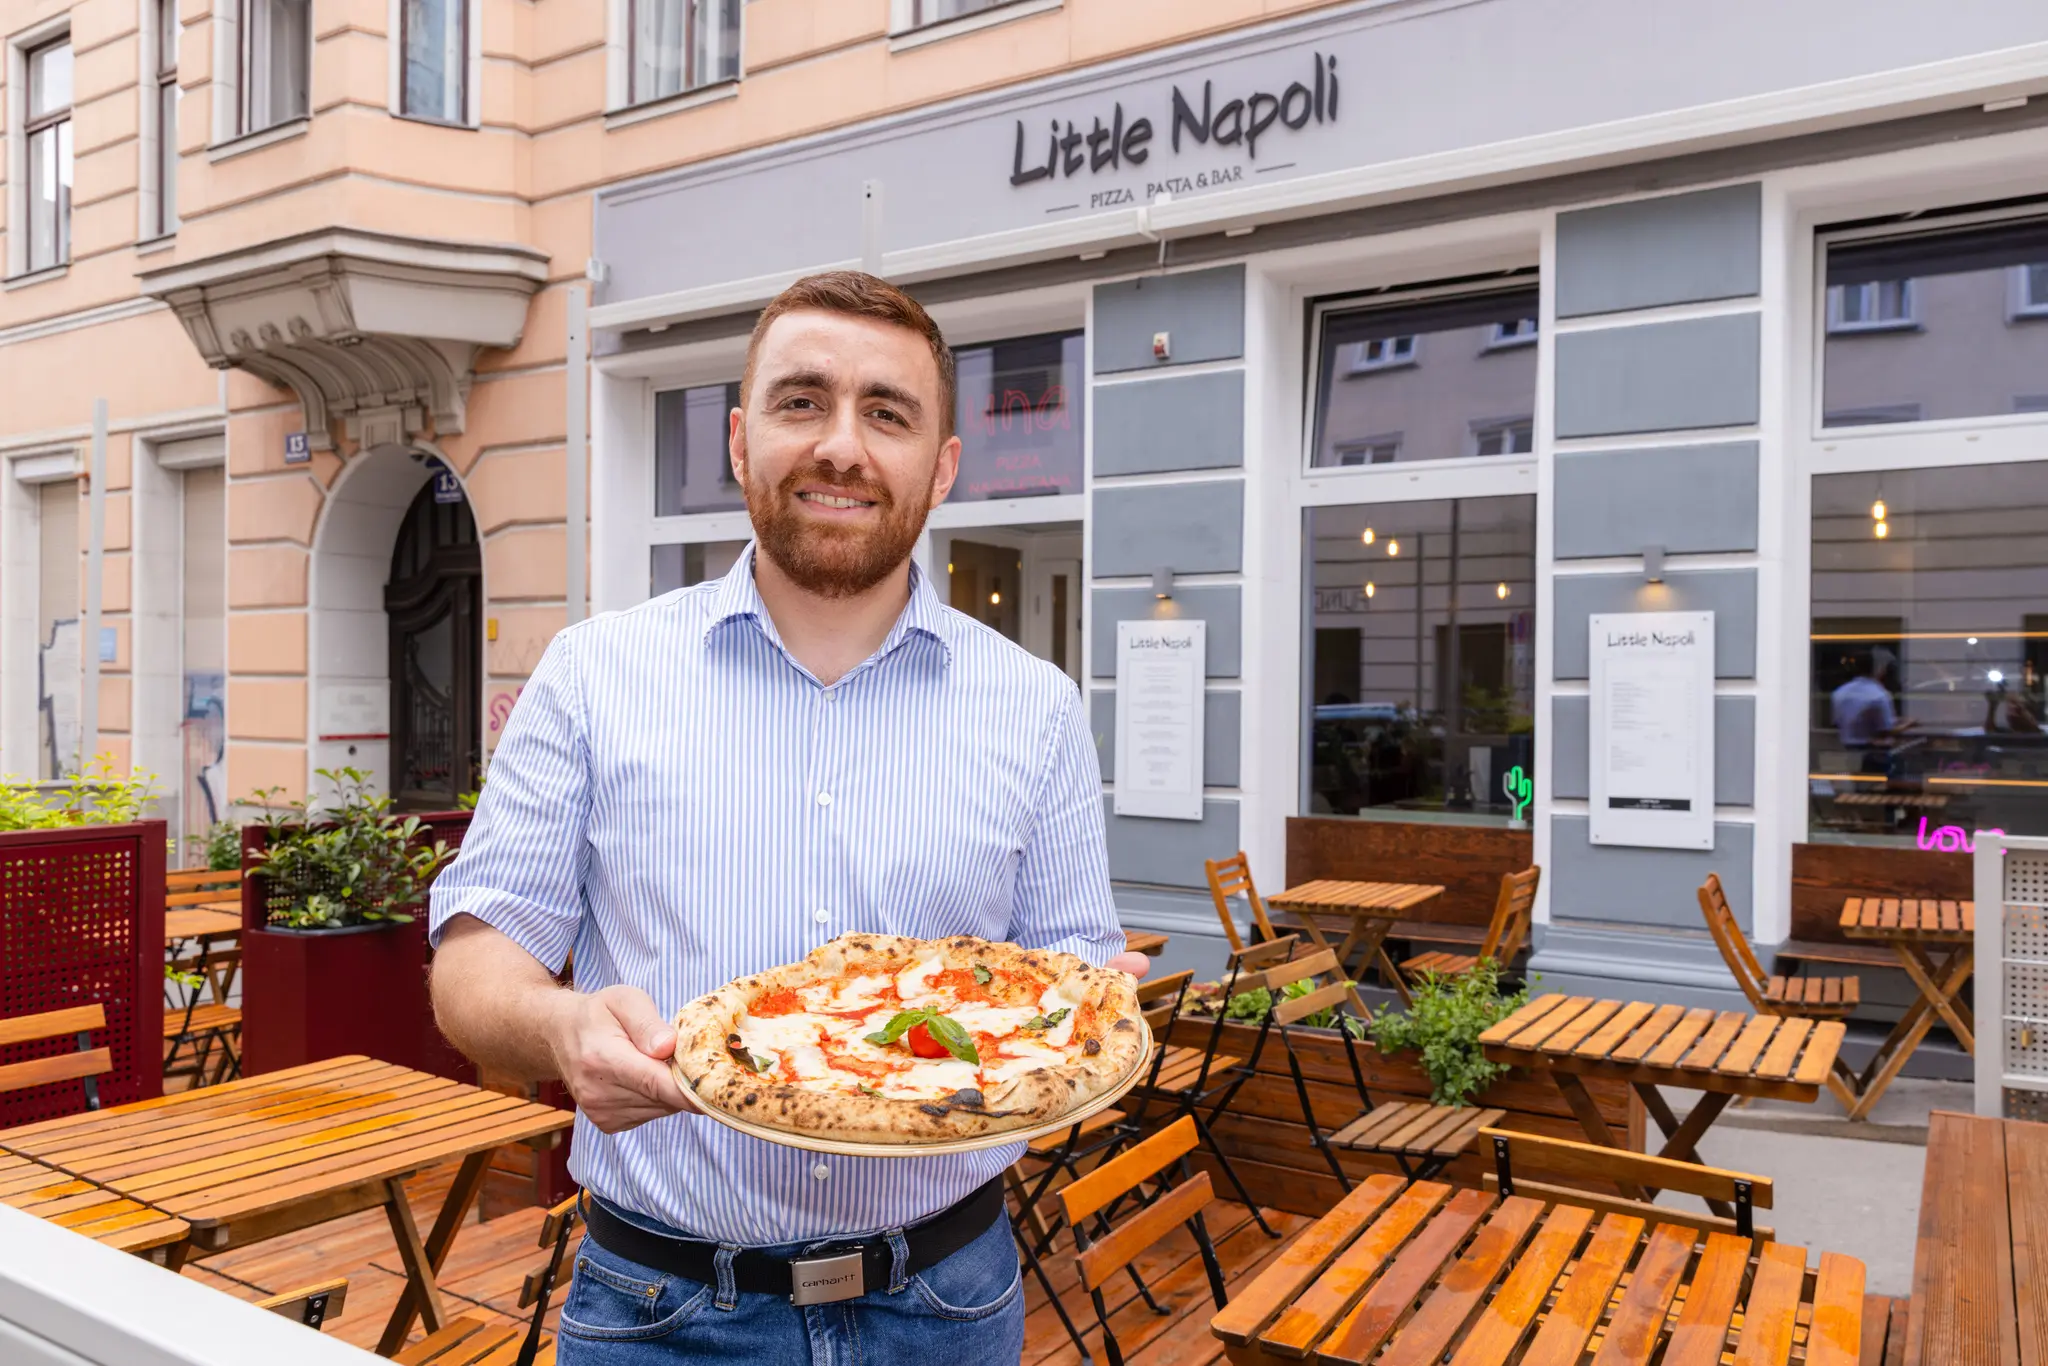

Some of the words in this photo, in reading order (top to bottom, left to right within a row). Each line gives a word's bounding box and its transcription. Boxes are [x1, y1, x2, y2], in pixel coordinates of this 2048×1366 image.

[1010, 102, 1153, 186] Little
[1171, 52, 1339, 160] Napoli
[1091, 188, 1135, 209] PIZZA
[1146, 177, 1193, 198] PASTA
[1196, 172, 1209, 188] &
[1211, 165, 1243, 185] BAR
[802, 1273, 856, 1288] carhartt
